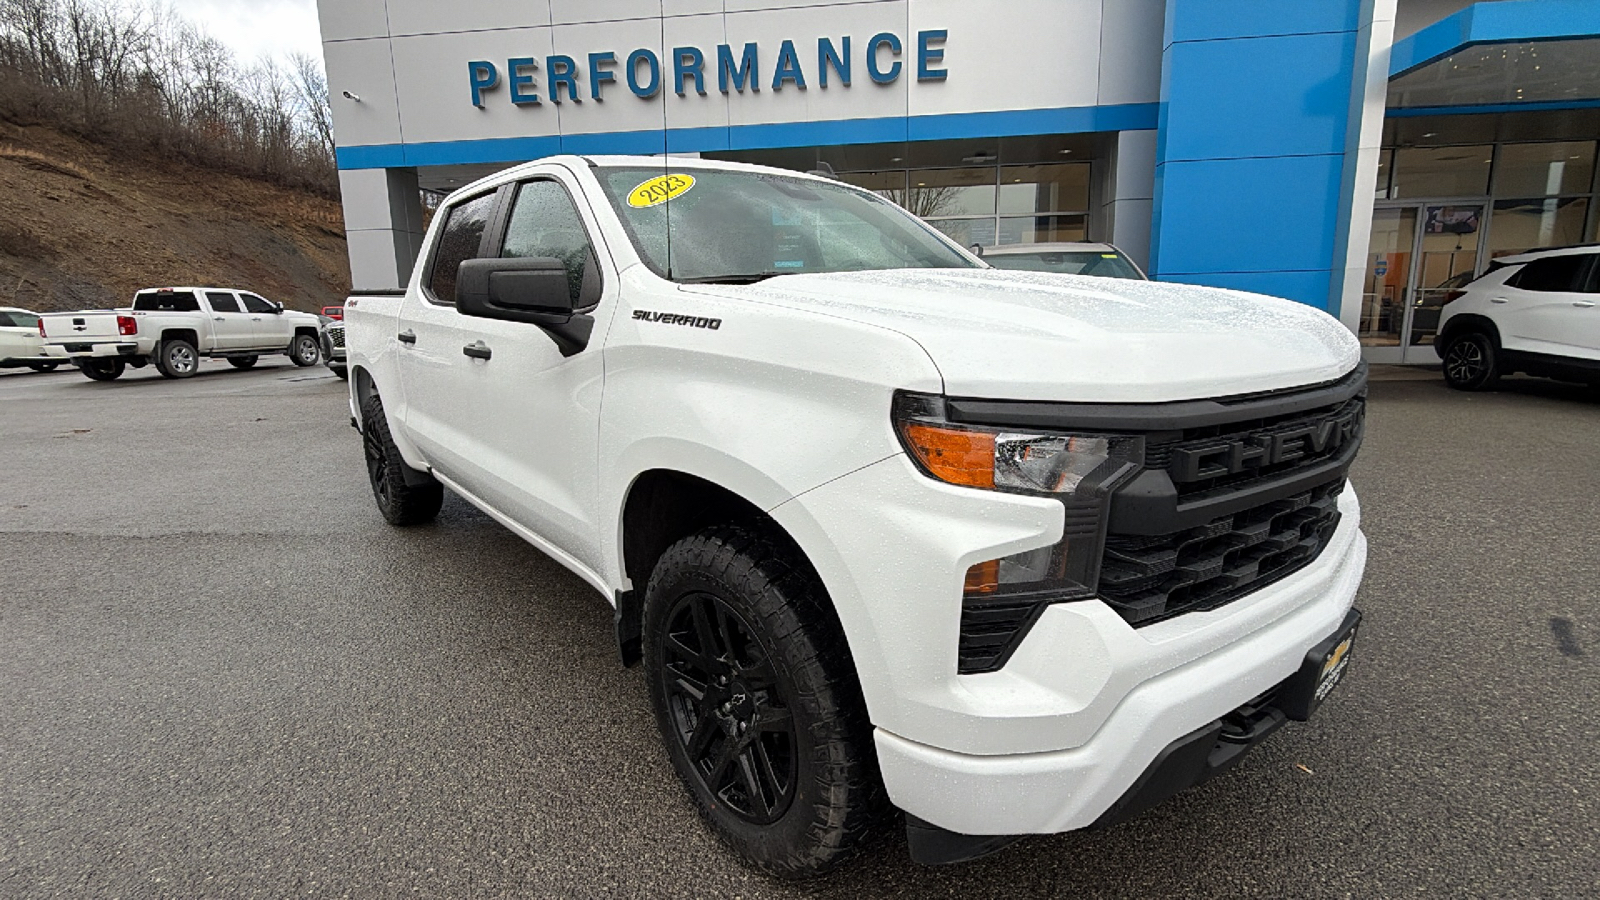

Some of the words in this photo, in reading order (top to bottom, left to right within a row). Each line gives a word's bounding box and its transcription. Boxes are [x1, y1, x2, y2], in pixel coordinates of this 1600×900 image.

[467, 29, 948, 109] PERFORMANCE
[639, 176, 686, 203] 2023
[631, 309, 723, 331] SILVERADO
